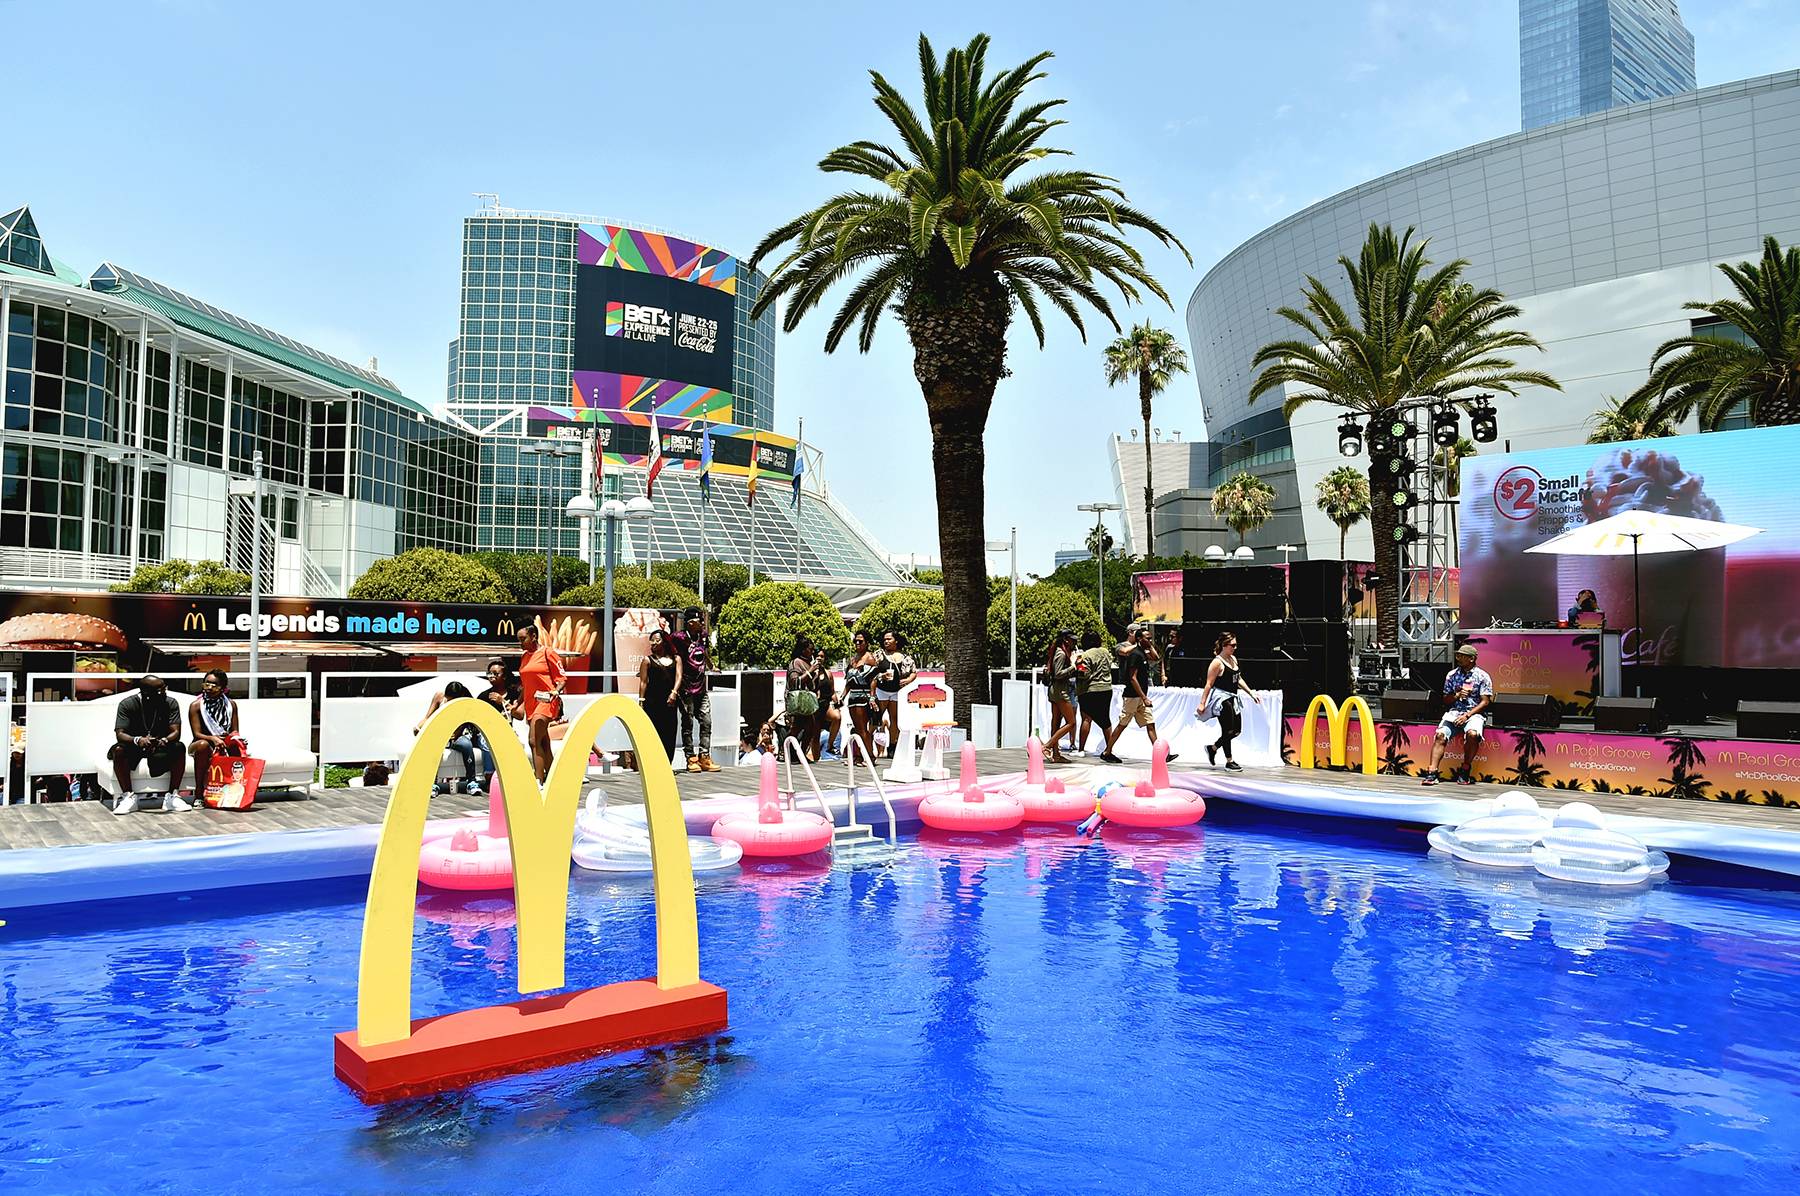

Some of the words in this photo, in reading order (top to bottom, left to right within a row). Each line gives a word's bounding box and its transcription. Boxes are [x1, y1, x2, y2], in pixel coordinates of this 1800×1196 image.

[624, 303, 663, 325] BET
[679, 313, 697, 326] JUNE
[624, 321, 671, 337] EXPERIENCE
[624, 331, 632, 339] AT
[644, 334, 656, 343] LIVE
[678, 322, 709, 337] PRESENTED
[709, 329, 717, 339] BY
[1538, 475, 1579, 491] Small
[1500, 478, 1536, 510] $2
[1576, 514, 1584, 524] &
[218, 608, 340, 637] Legends
[346, 612, 420, 634] made
[425, 612, 488, 635] here.
[1510, 651, 1541, 665] Pool
[1572, 743, 1599, 757] Pool
[1602, 745, 1651, 760] Groove
[1737, 751, 1770, 766] Pool
